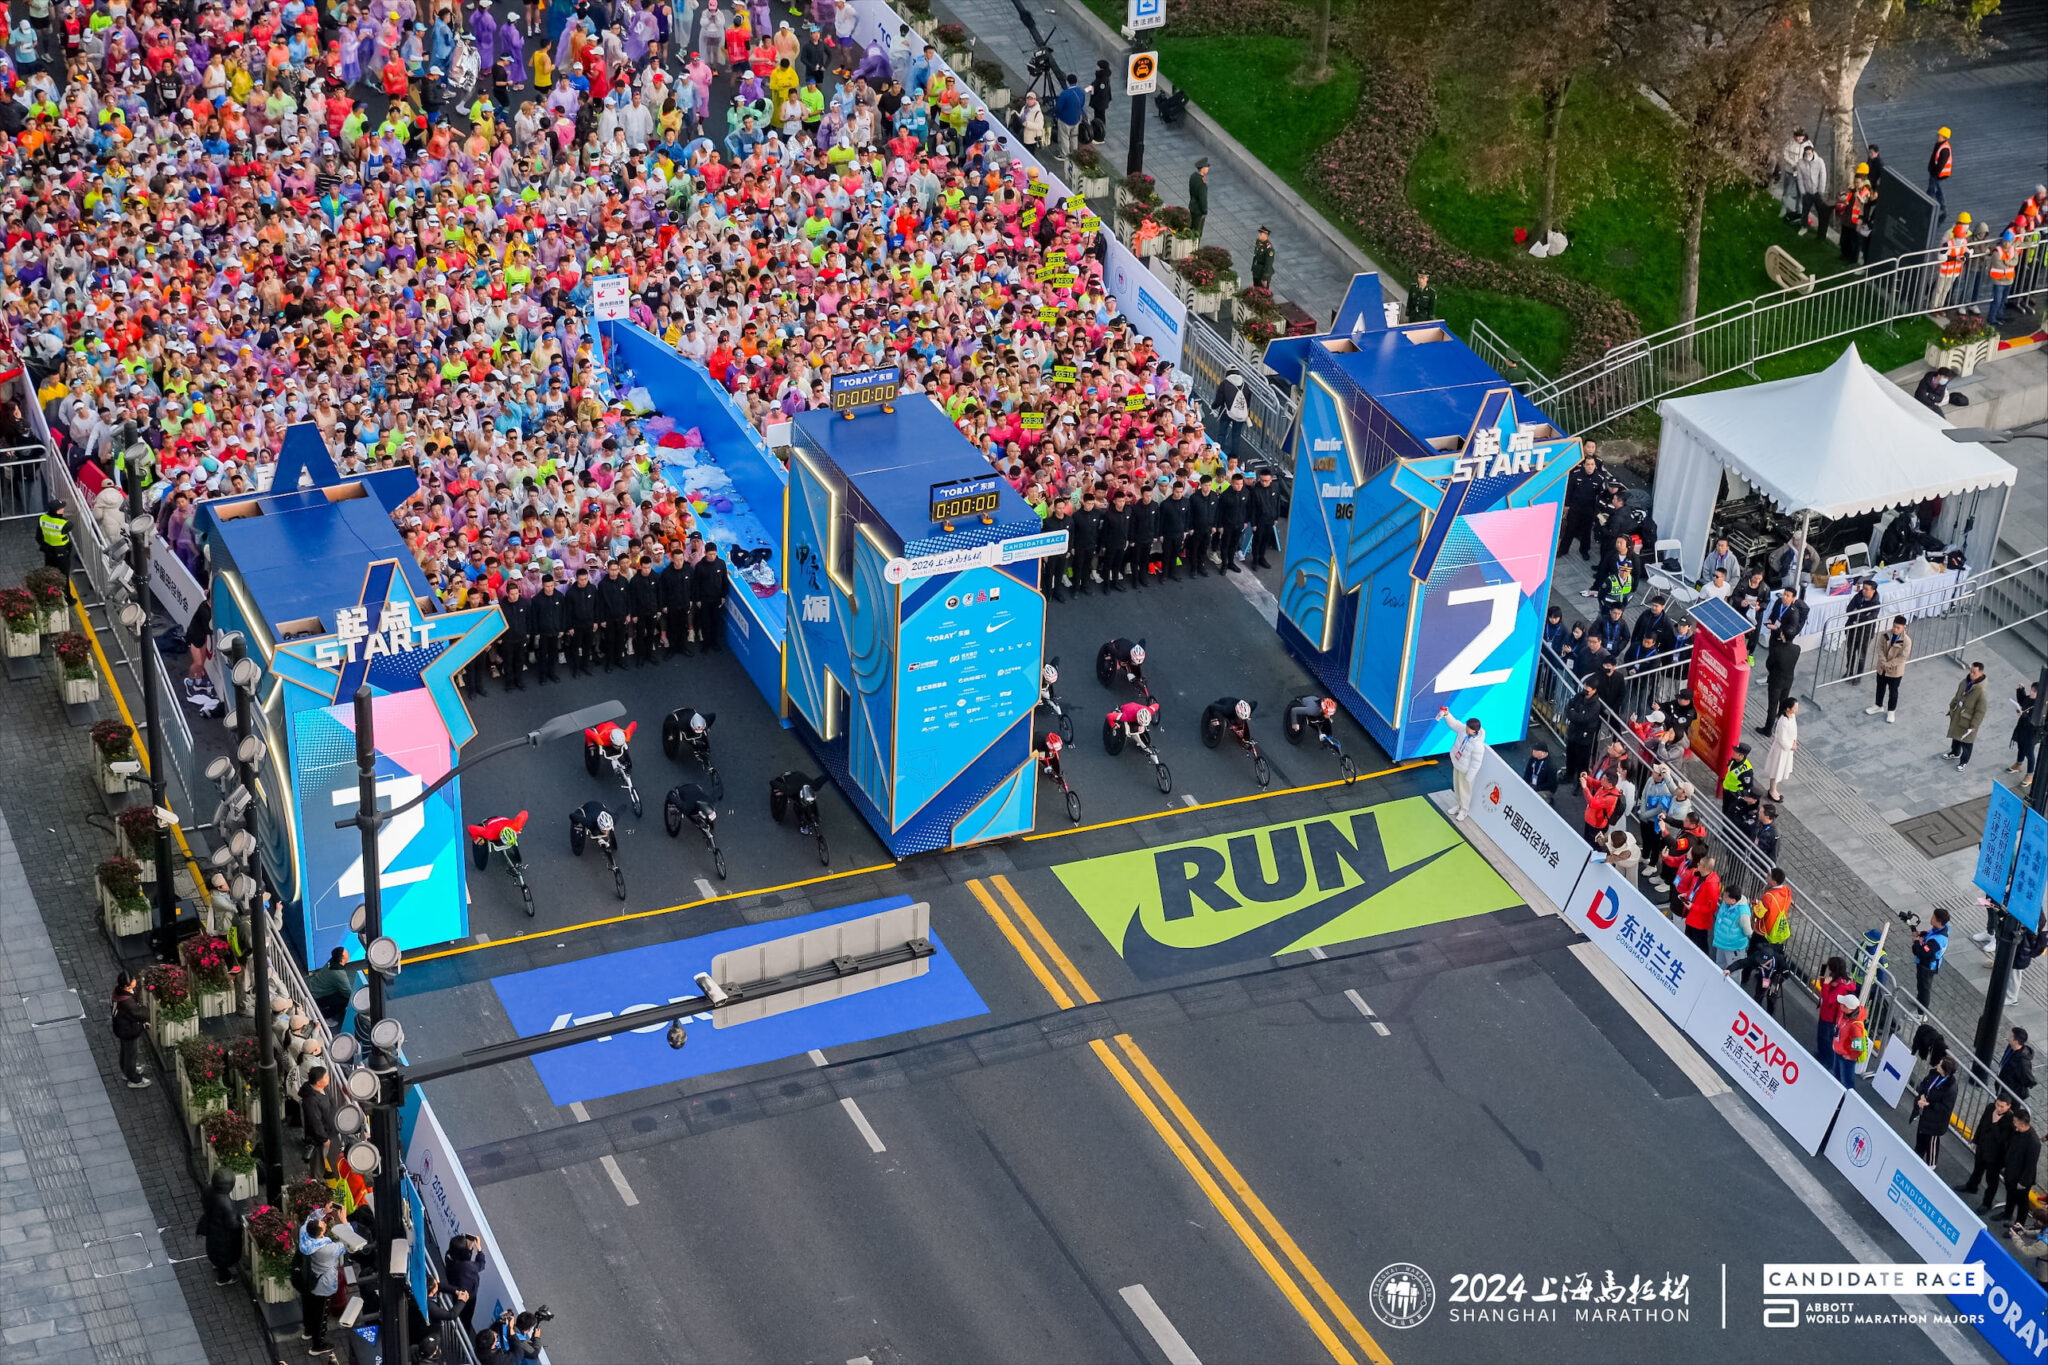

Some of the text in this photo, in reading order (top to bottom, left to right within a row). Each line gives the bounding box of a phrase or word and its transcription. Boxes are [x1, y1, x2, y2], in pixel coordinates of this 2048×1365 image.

[837, 385, 894, 408] 0:00:00
[1473, 424, 1536, 457] 起点
[1451, 447, 1552, 483] START
[936, 494, 996, 519] 0:00:00
[1321, 483, 1340, 498] Run
[1335, 503, 1354, 520] BIG
[336, 601, 413, 641] 起点
[315, 623, 436, 669] START
[989, 641, 1032, 654] VOLVO
[1503, 804, 1560, 869] 中国田径协会
[1154, 810, 1391, 922] RUN
[1616, 933, 1677, 996] DONGHAO LANSHENG
[1620, 913, 1686, 989] 东浩兰生
[1723, 1034, 1780, 1095] 东浩兰生会展
[1731, 1010, 1799, 1085] DEXPO
[1895, 1174, 1957, 1240] CANDIDATE RACE
